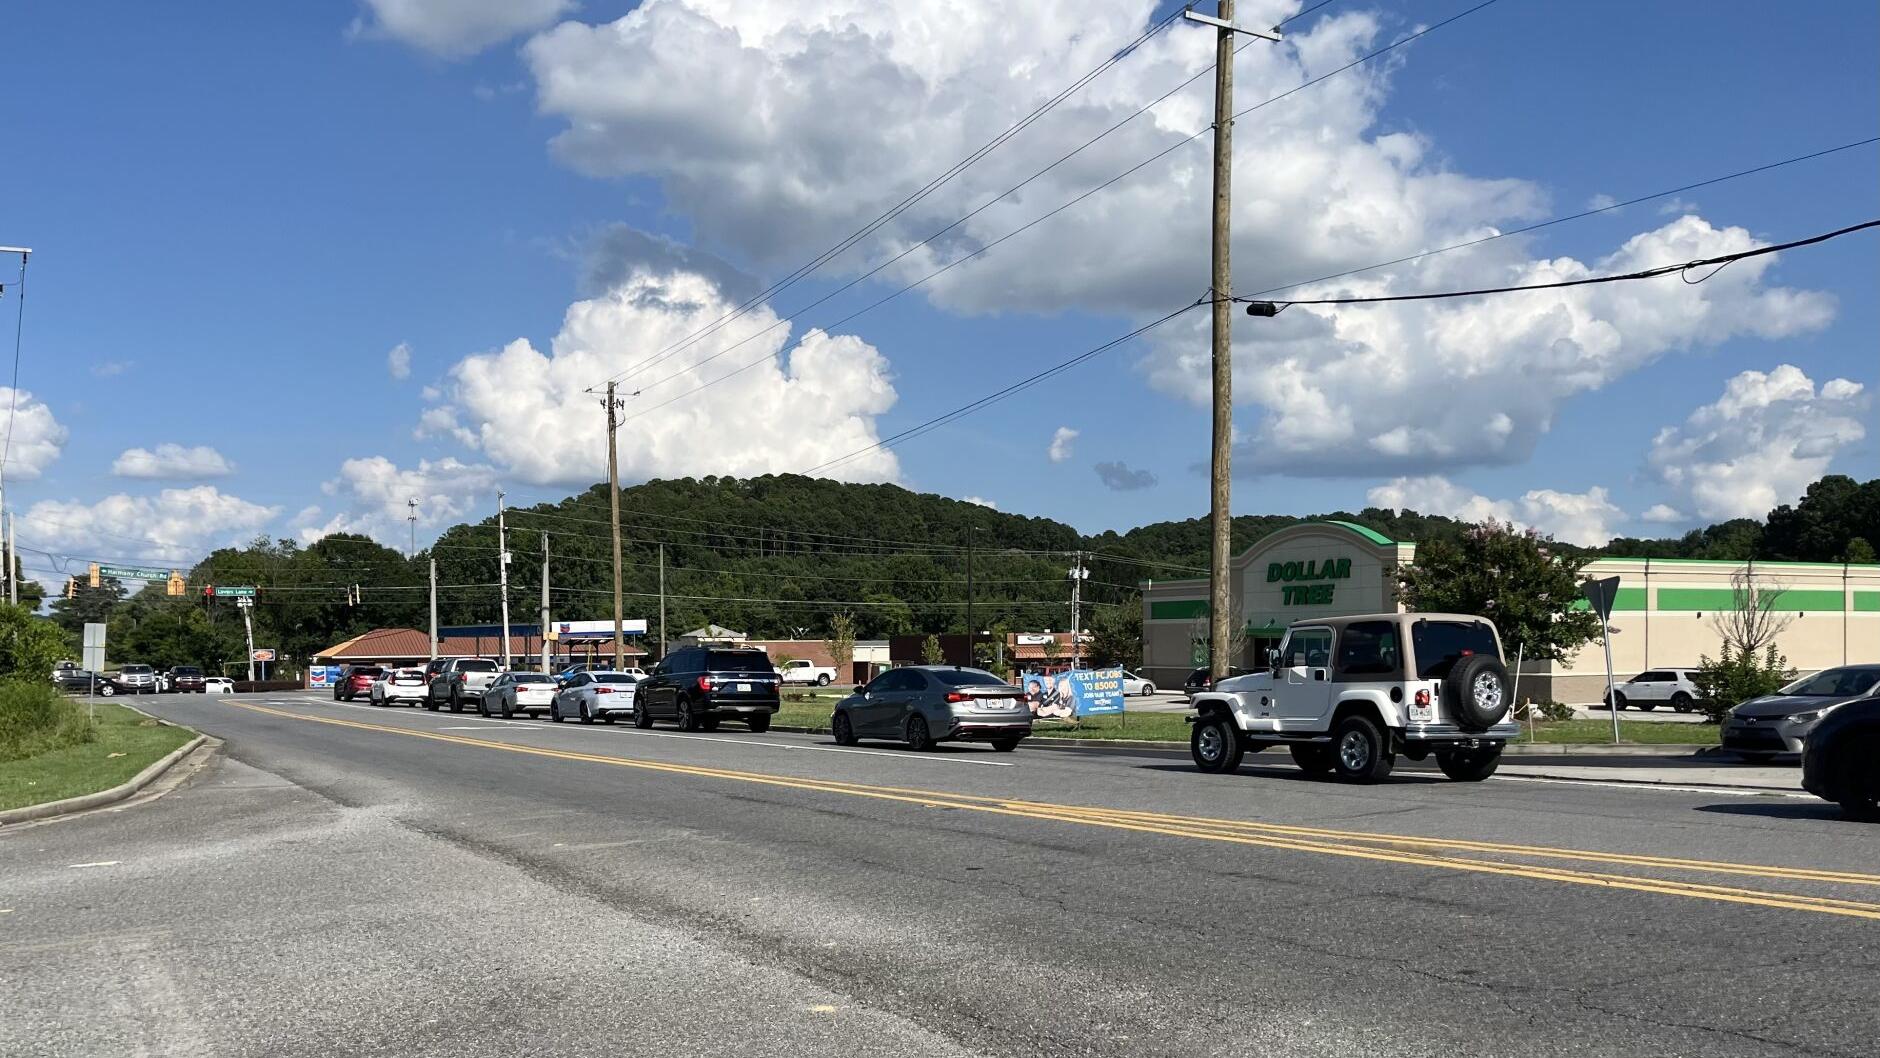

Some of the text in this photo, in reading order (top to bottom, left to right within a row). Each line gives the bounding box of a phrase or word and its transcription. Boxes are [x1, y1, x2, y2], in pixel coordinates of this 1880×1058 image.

[136, 571, 158, 579] Church
[1266, 558, 1352, 582] DOLLAR
[1281, 584, 1335, 605] TREE
[1075, 670, 1122, 681] TEXT FCJOBS
[1084, 682, 1093, 690] TO
